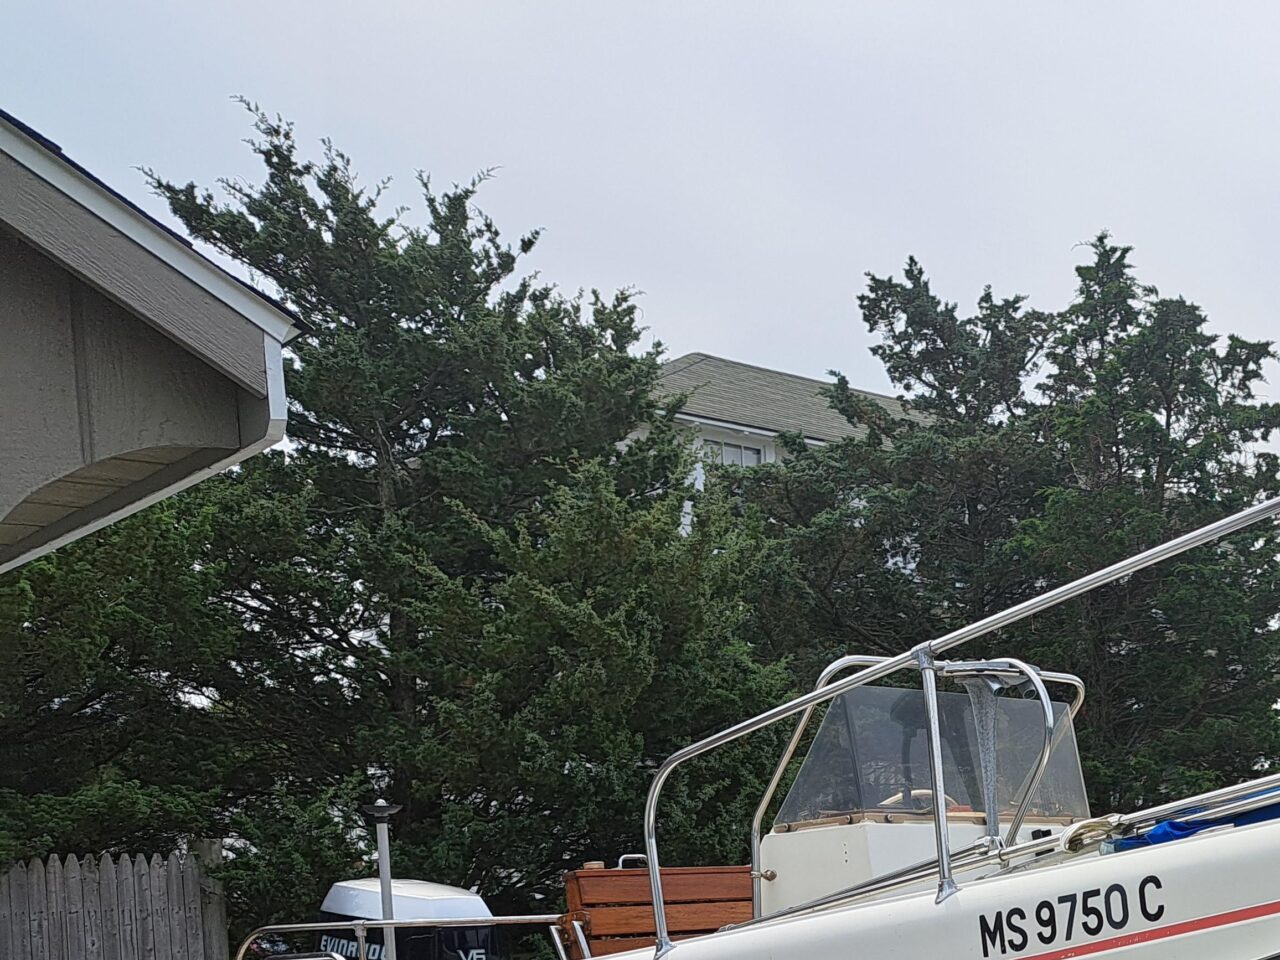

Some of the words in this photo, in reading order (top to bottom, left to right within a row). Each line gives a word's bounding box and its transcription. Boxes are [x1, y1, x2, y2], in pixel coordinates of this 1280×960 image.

[979, 908, 1028, 958] MS
[1035, 883, 1130, 945] 9750
[1138, 875, 1165, 922] C
